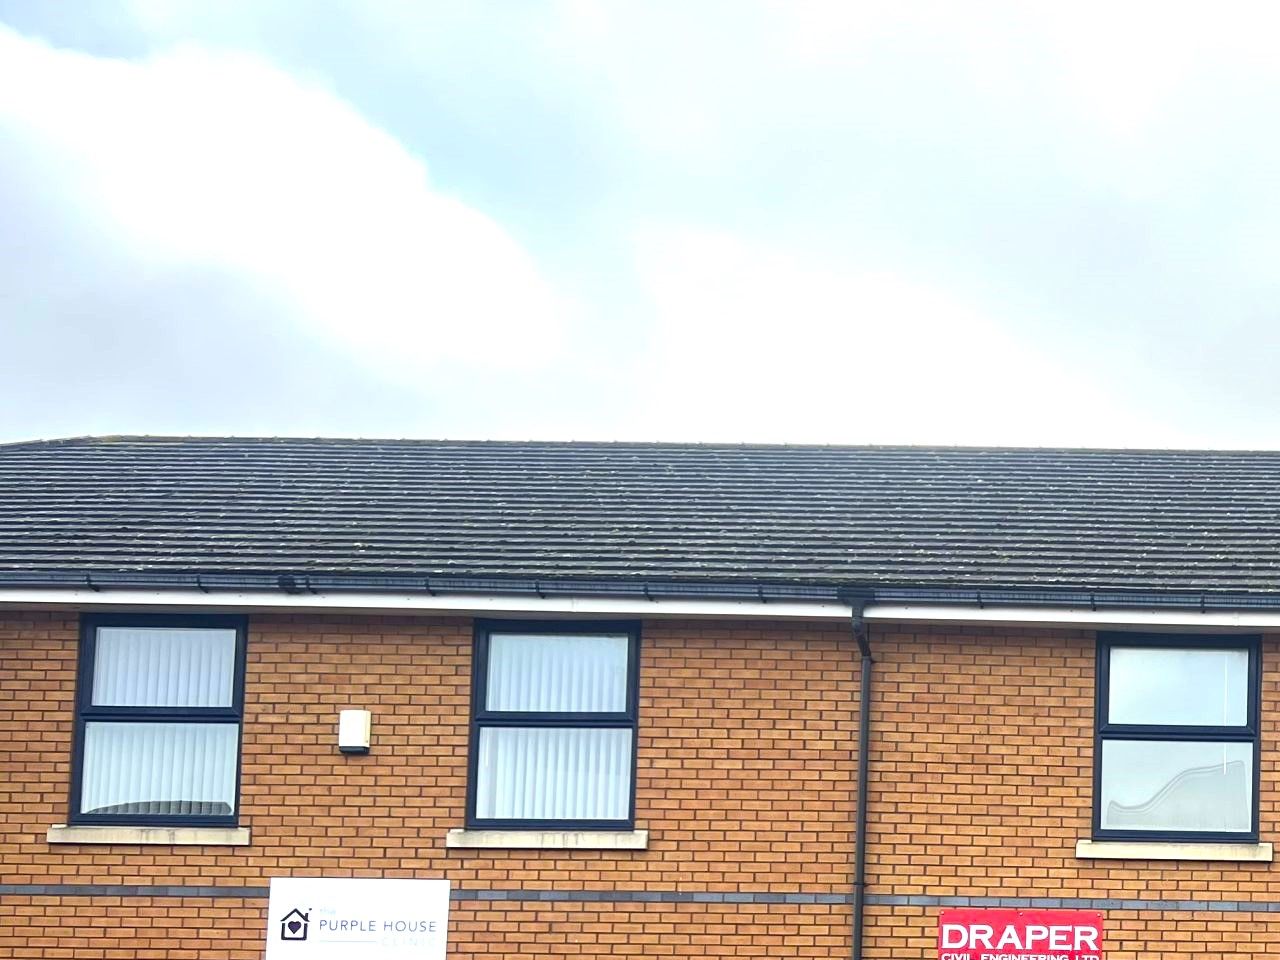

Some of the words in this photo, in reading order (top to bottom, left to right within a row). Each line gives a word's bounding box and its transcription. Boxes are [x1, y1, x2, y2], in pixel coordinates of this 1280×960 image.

[319, 919, 376, 932] PURPLE
[383, 920, 437, 932] HOUSE
[941, 924, 1100, 951] DRAPER
